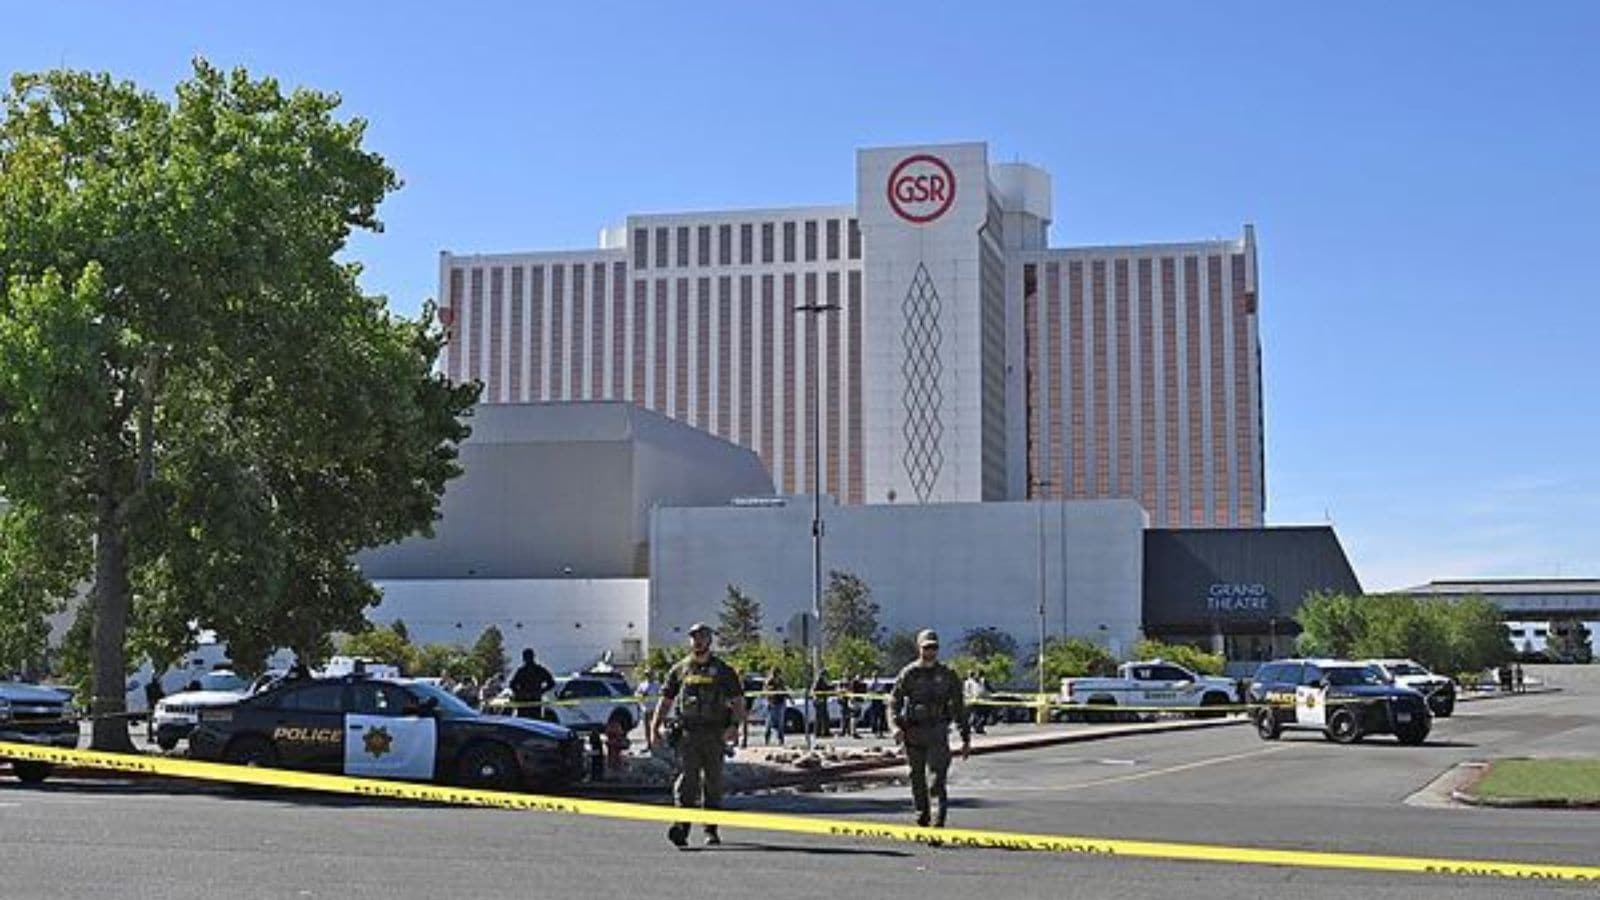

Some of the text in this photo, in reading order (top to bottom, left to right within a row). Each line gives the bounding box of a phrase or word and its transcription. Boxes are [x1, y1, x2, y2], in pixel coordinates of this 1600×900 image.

[896, 174, 945, 203] GSR
[1209, 583, 1265, 596] GRAND
[1206, 597, 1268, 609] THEATRE
[273, 727, 342, 742] POLICE
